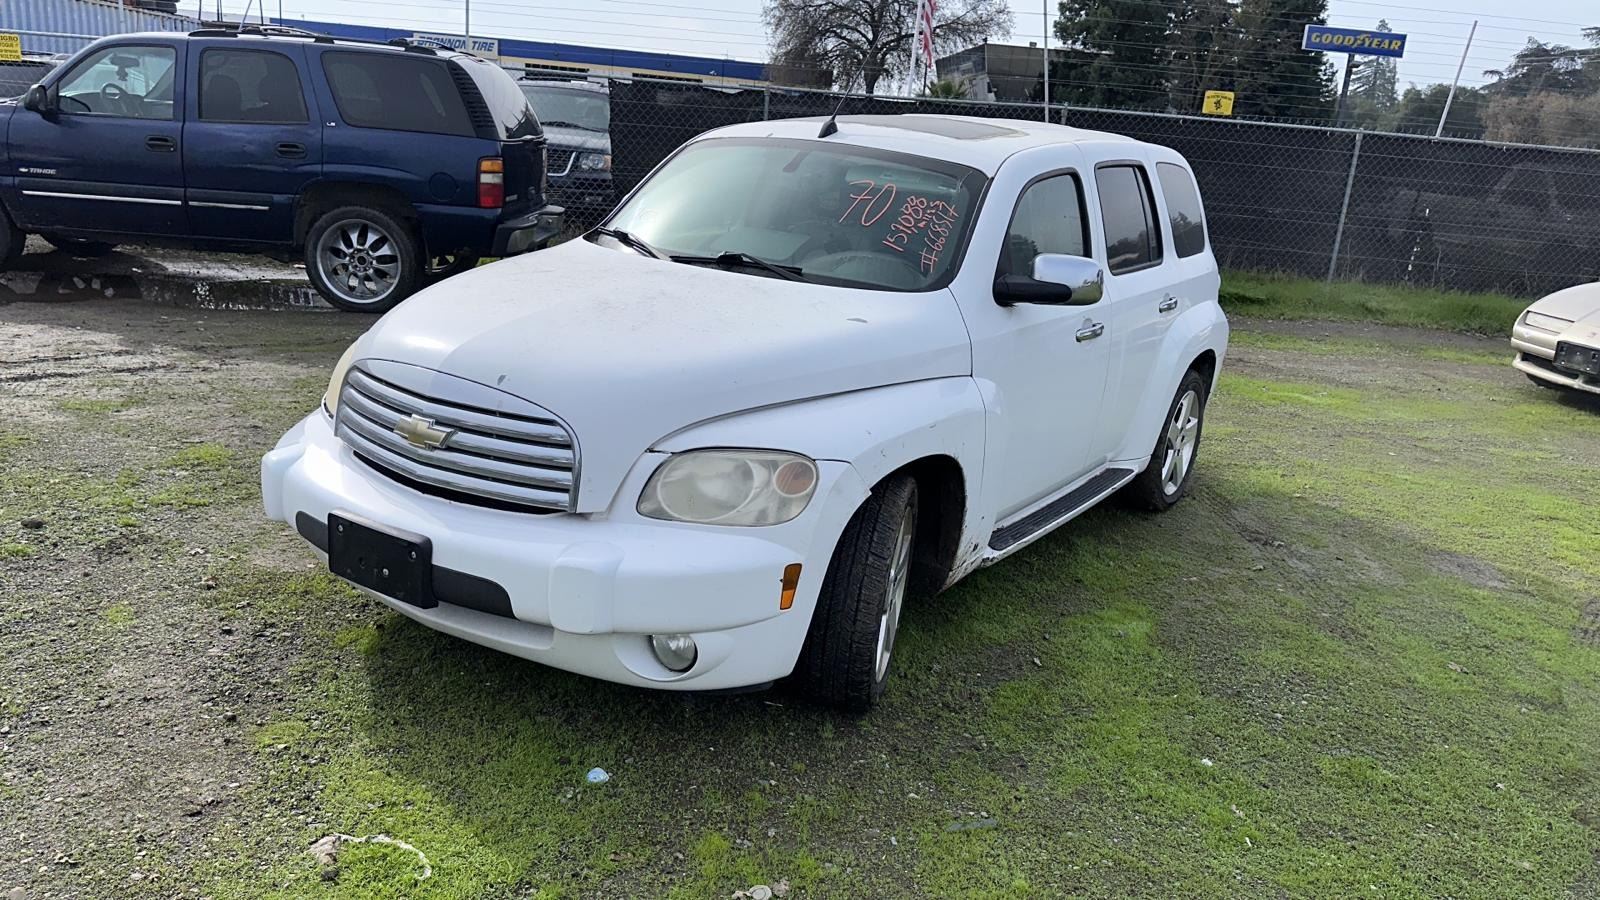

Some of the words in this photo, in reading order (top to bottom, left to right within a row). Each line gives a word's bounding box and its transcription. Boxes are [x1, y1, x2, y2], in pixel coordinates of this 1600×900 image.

[471, 41, 495, 52] TIRE
[1310, 32, 1402, 50] GOODYEAR
[29, 167, 57, 175] TAHOE
[839, 180, 897, 226] 70
